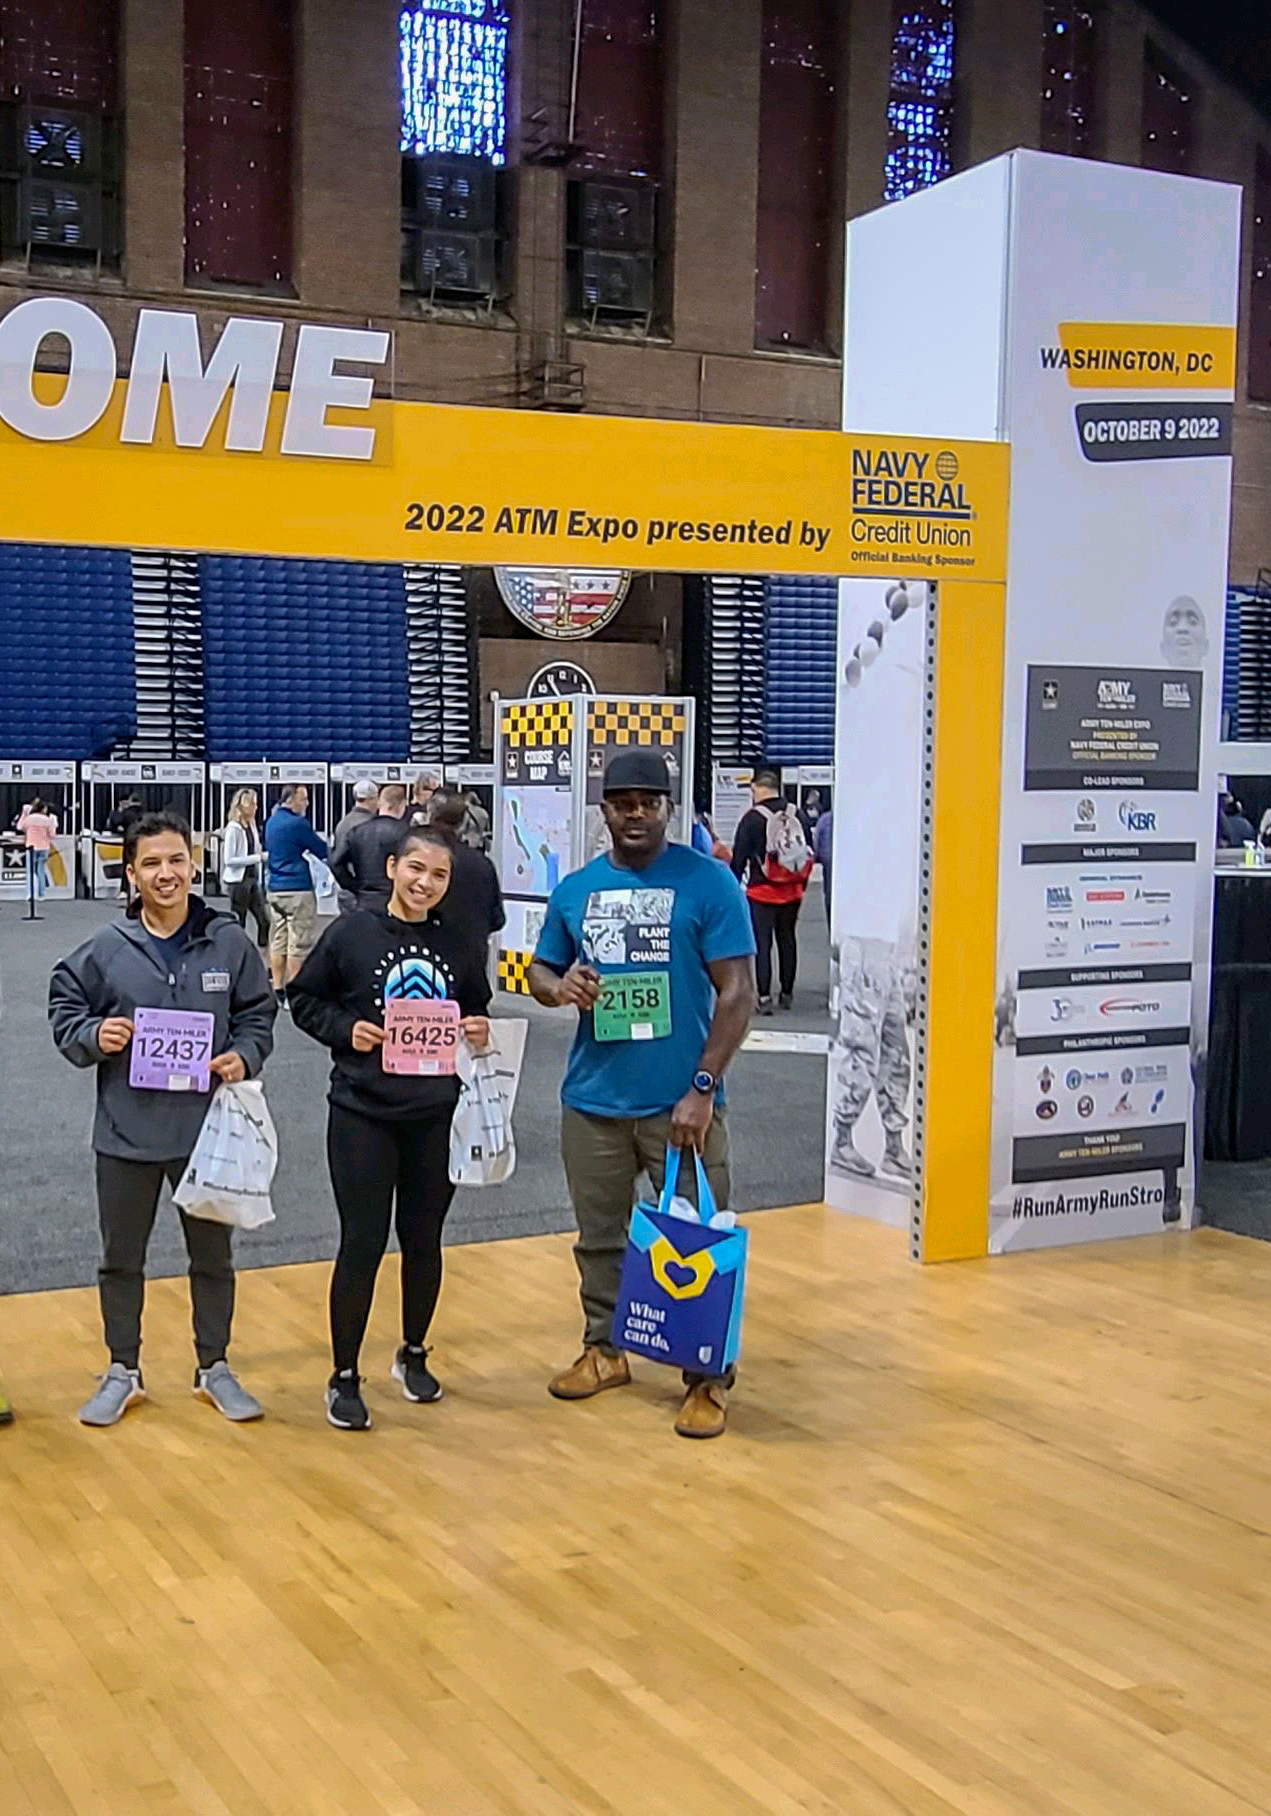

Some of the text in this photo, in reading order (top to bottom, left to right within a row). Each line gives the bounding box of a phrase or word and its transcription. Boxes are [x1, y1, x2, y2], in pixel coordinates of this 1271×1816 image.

[1040, 348, 1213, 376] WASHINGTON, DC
[1083, 417, 1220, 443] OCTOBER 9 2022
[852, 449, 930, 479] NAVY
[852, 478, 971, 510] FEDERAL
[405, 503, 830, 552] 2022 ATM Expo presented by
[851, 519, 971, 546] Credit Union
[850, 551, 975, 566] Official Banking Sponsor
[1129, 812, 1156, 831] KBR
[638, 927, 670, 938] PLANT
[650, 939, 670, 950] THE
[630, 950, 670, 962] CHANGE
[603, 988, 660, 1010] 2158
[388, 1026, 456, 1046] 16425
[137, 1038, 209, 1061] 12437
[1013, 1185, 1163, 1218] #RunArmyRunStro
[630, 1301, 666, 1323] What
[626, 1316, 657, 1333] care
[624, 1329, 649, 1345] can
